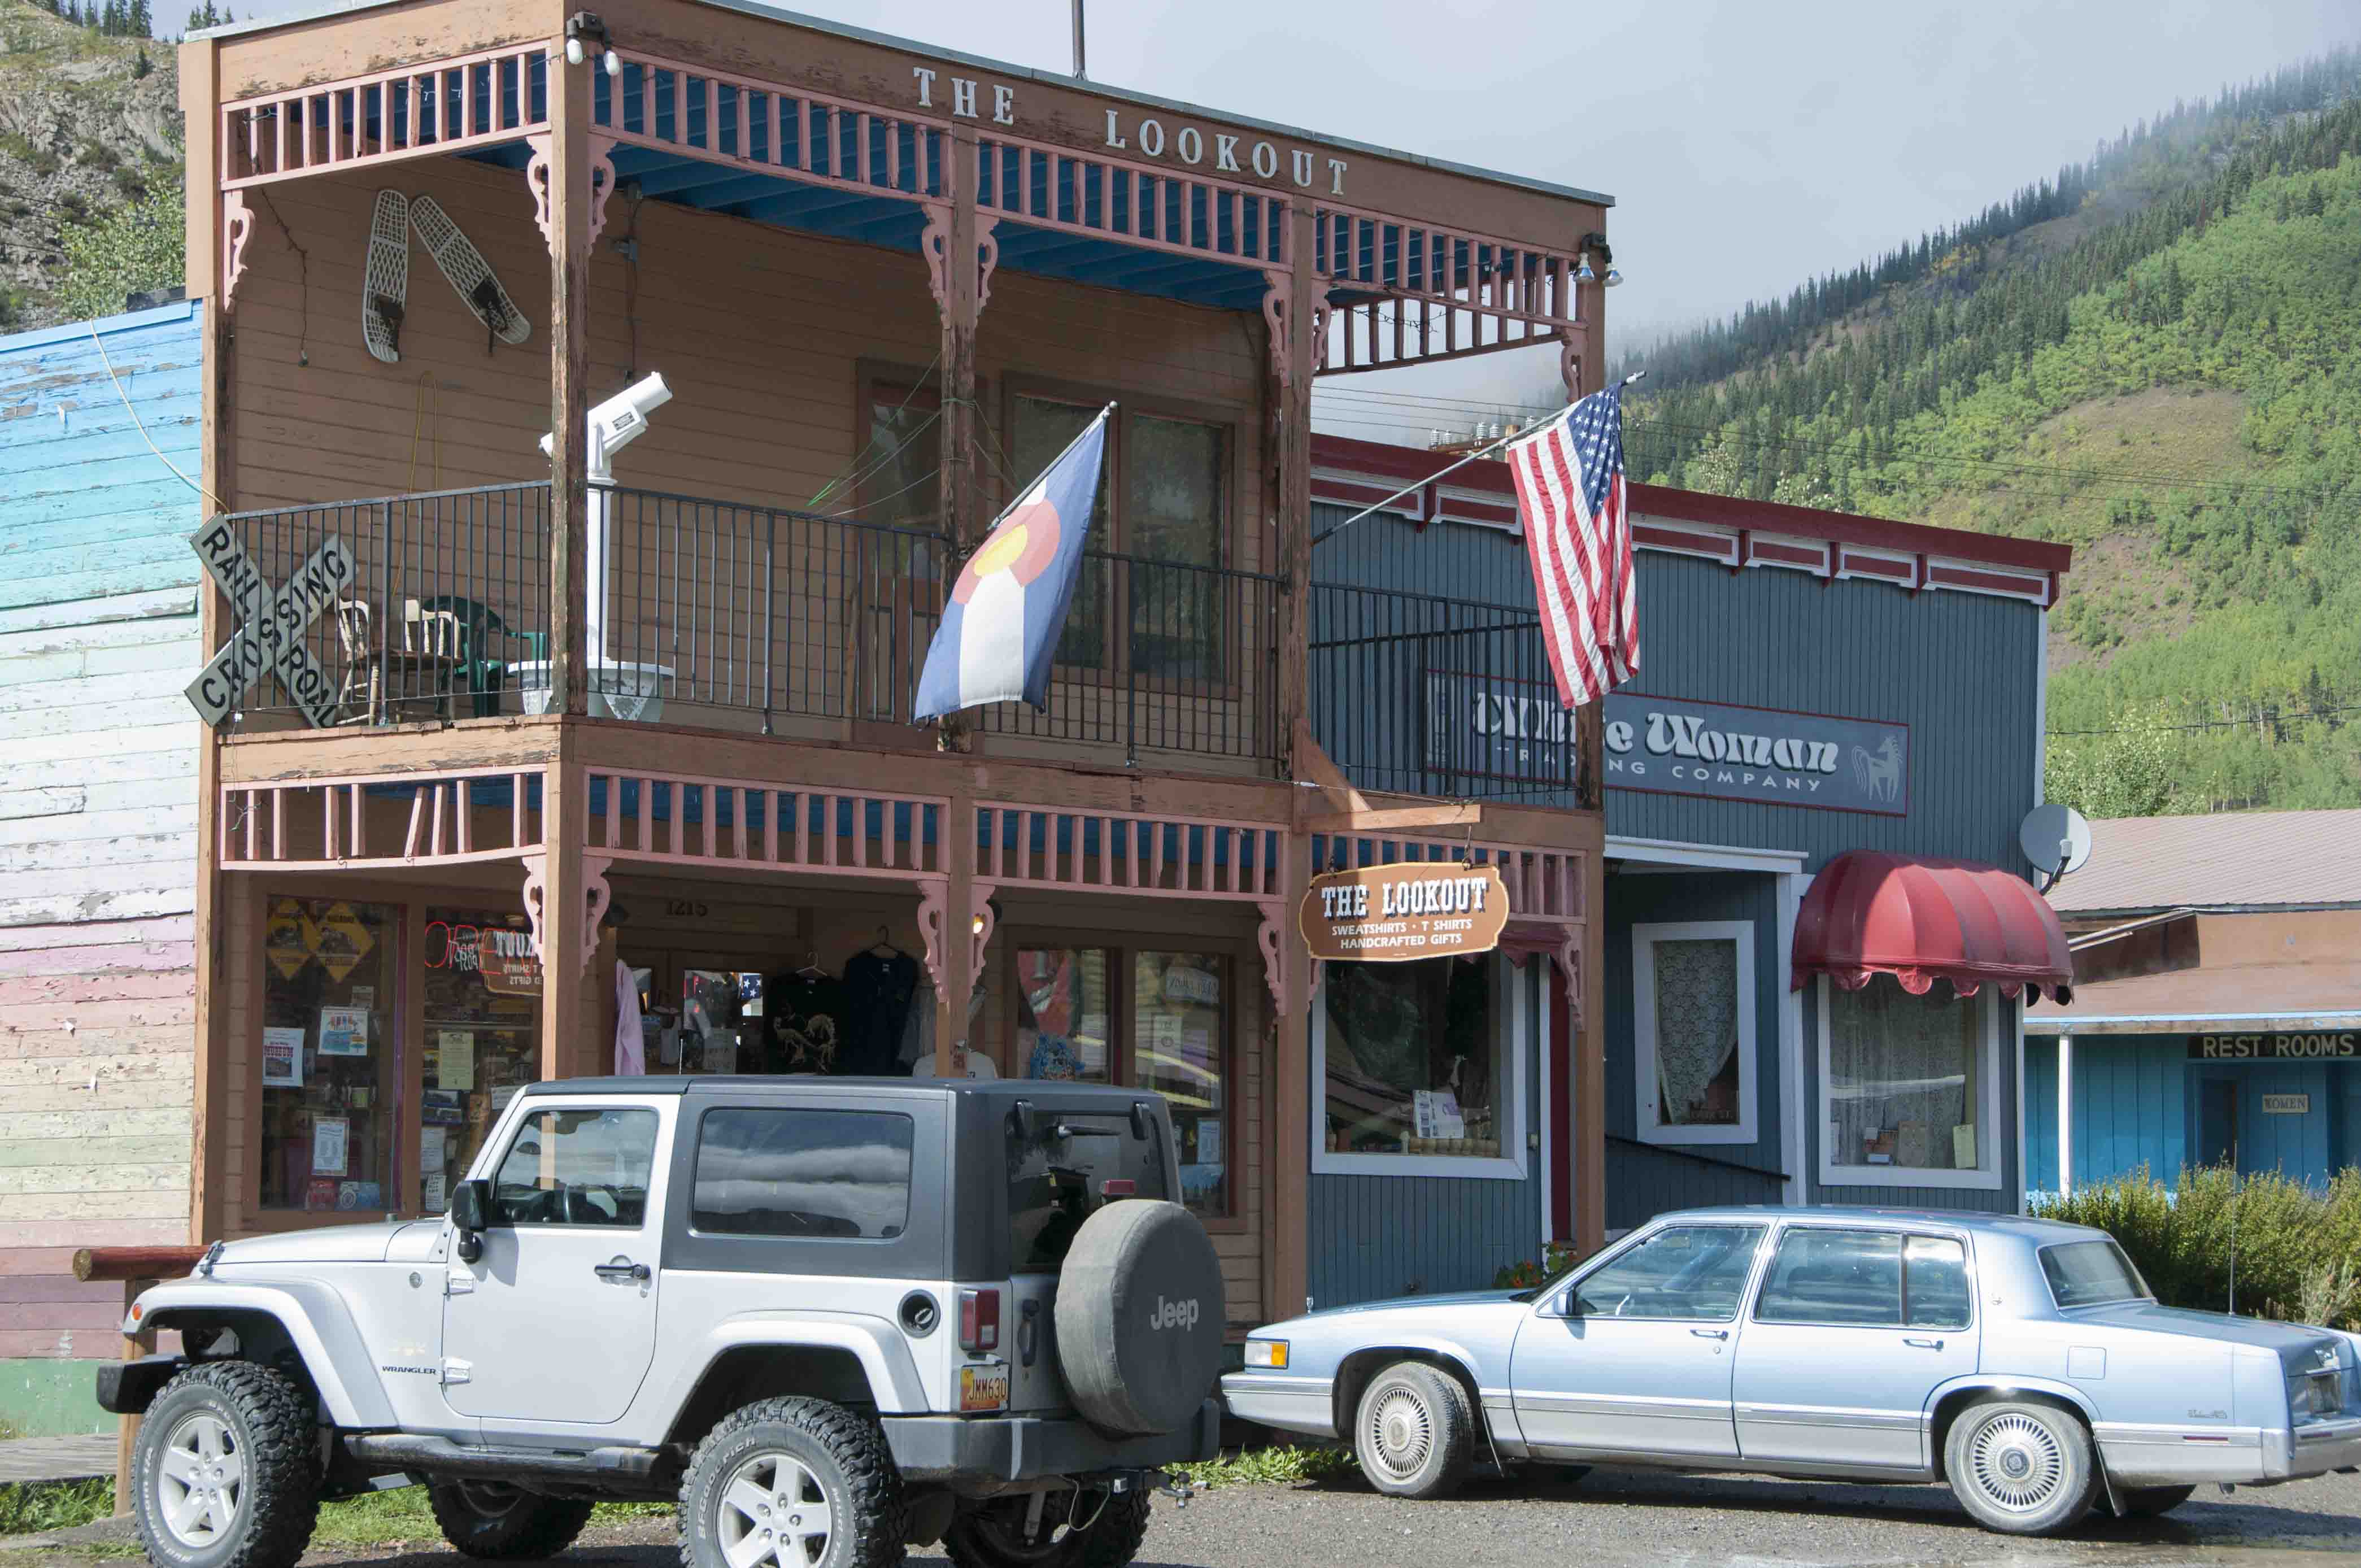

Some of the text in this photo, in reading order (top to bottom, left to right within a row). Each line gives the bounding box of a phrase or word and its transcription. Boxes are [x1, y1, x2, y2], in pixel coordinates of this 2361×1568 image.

[913, 66, 1348, 195] THE LOOKOUT
[202, 526, 259, 615] RAIL
[202, 551, 346, 708] CROSSING
[1645, 712, 1839, 773] Woman
[1496, 746, 1822, 792] TRADNG COMPANY
[667, 900, 708, 917] 1215
[1322, 877, 1488, 920] THE LOOKOUT
[1331, 919, 1473, 936] SWEATSHIRTS T SHIRTS
[1340, 933, 1462, 949] HANDCRAFTED GIFTS
[2203, 1034, 2355, 1058] REST ROOMS
[1151, 1295, 1199, 1331] Jeep
[382, 1365, 437, 1375] WRANGLER
[969, 1377, 1007, 1401] JMM630
